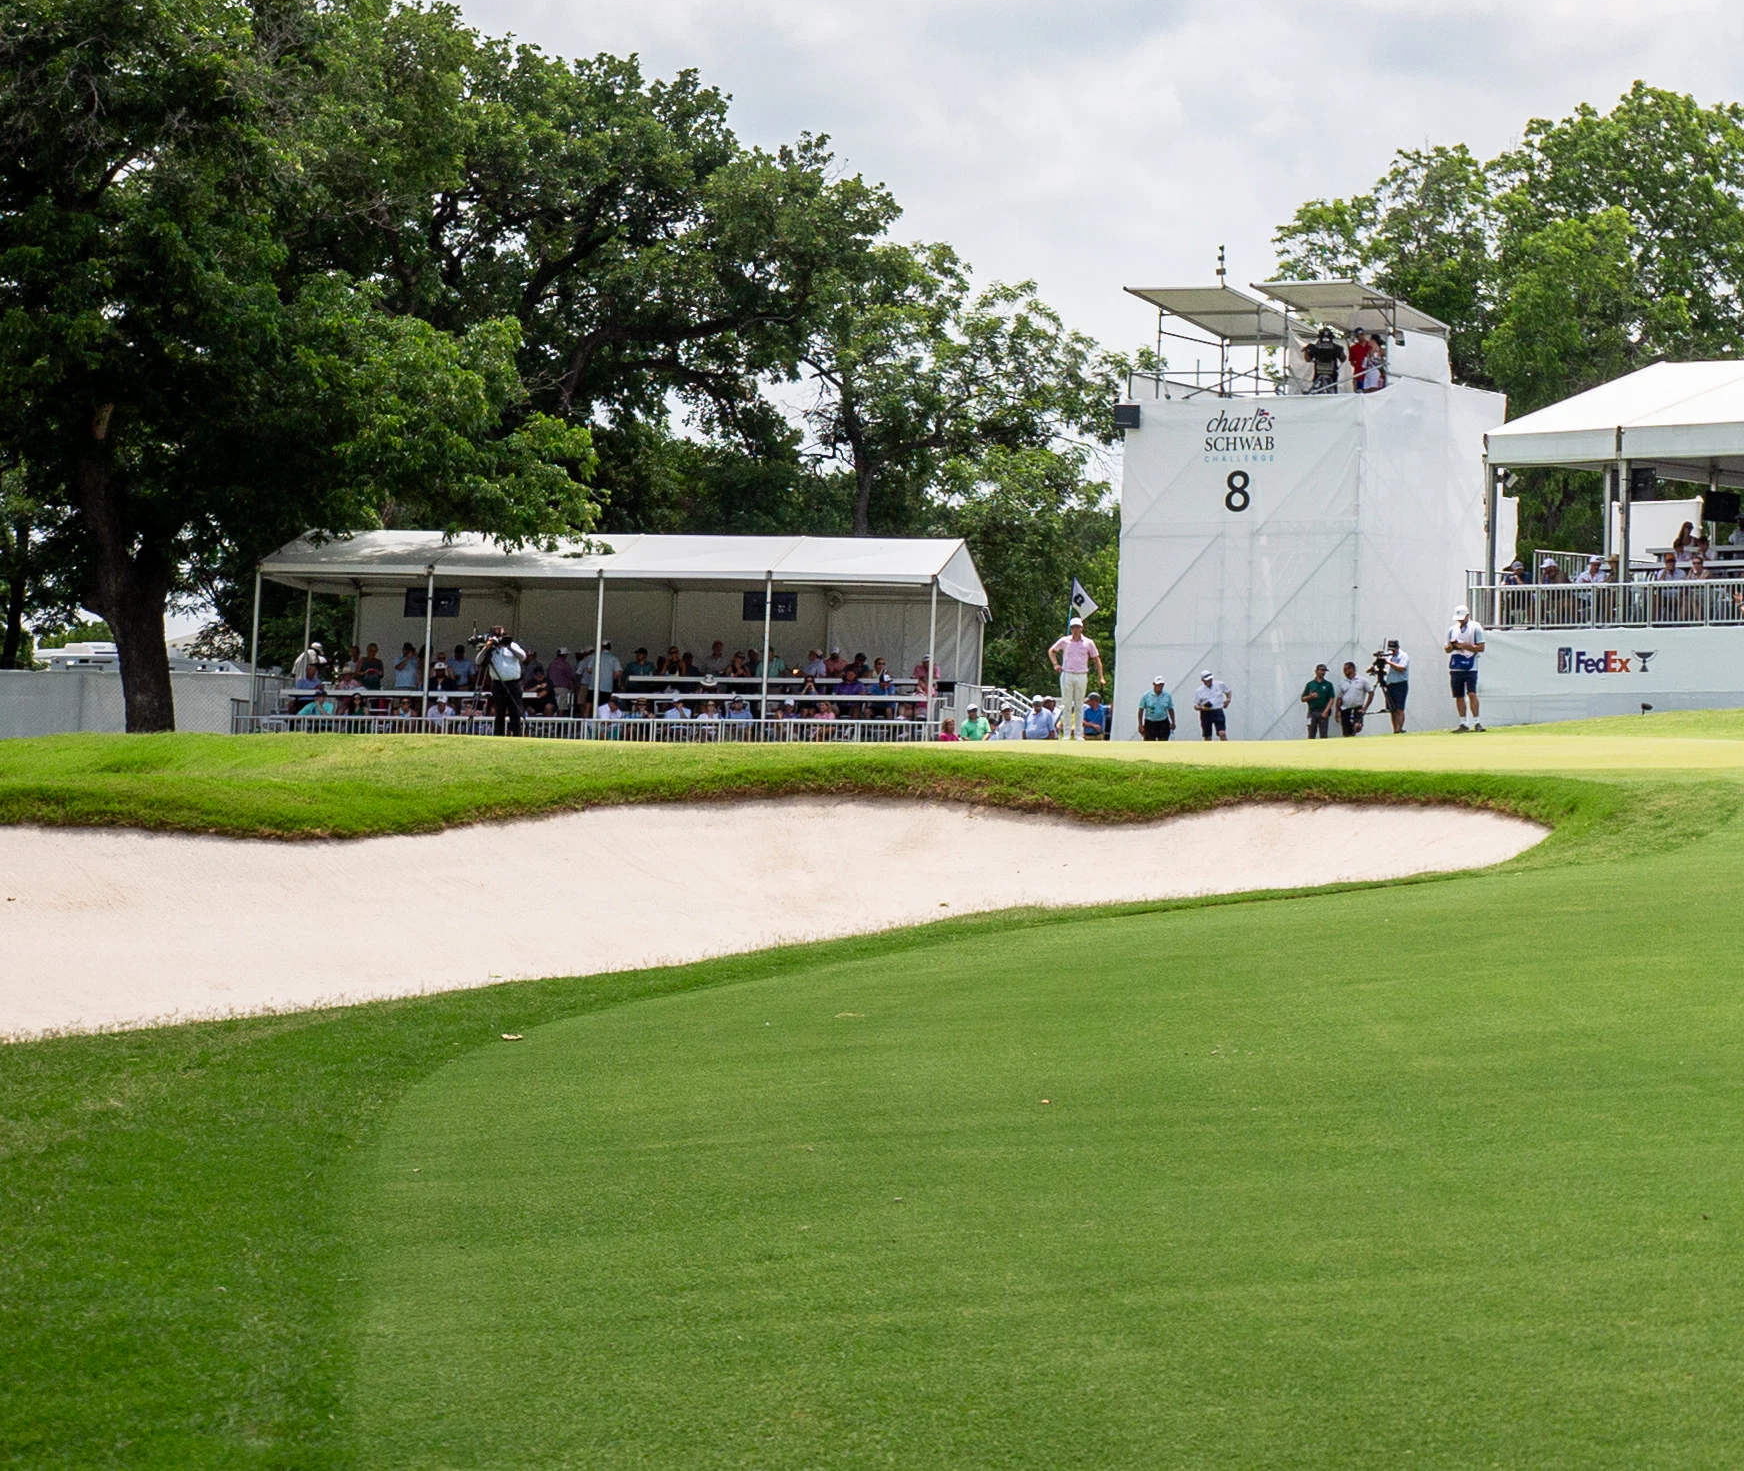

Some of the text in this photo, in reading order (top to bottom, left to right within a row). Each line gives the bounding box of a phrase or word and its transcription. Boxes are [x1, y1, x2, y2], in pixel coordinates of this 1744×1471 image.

[1206, 407, 1276, 433] charles
[1204, 436, 1275, 452] SCHWAB
[1203, 454, 1274, 463] CHALLENGE
[1225, 470, 1250, 512] 8
[1073, 592, 1085, 607] 8
[1575, 650, 1631, 673] FedEx
